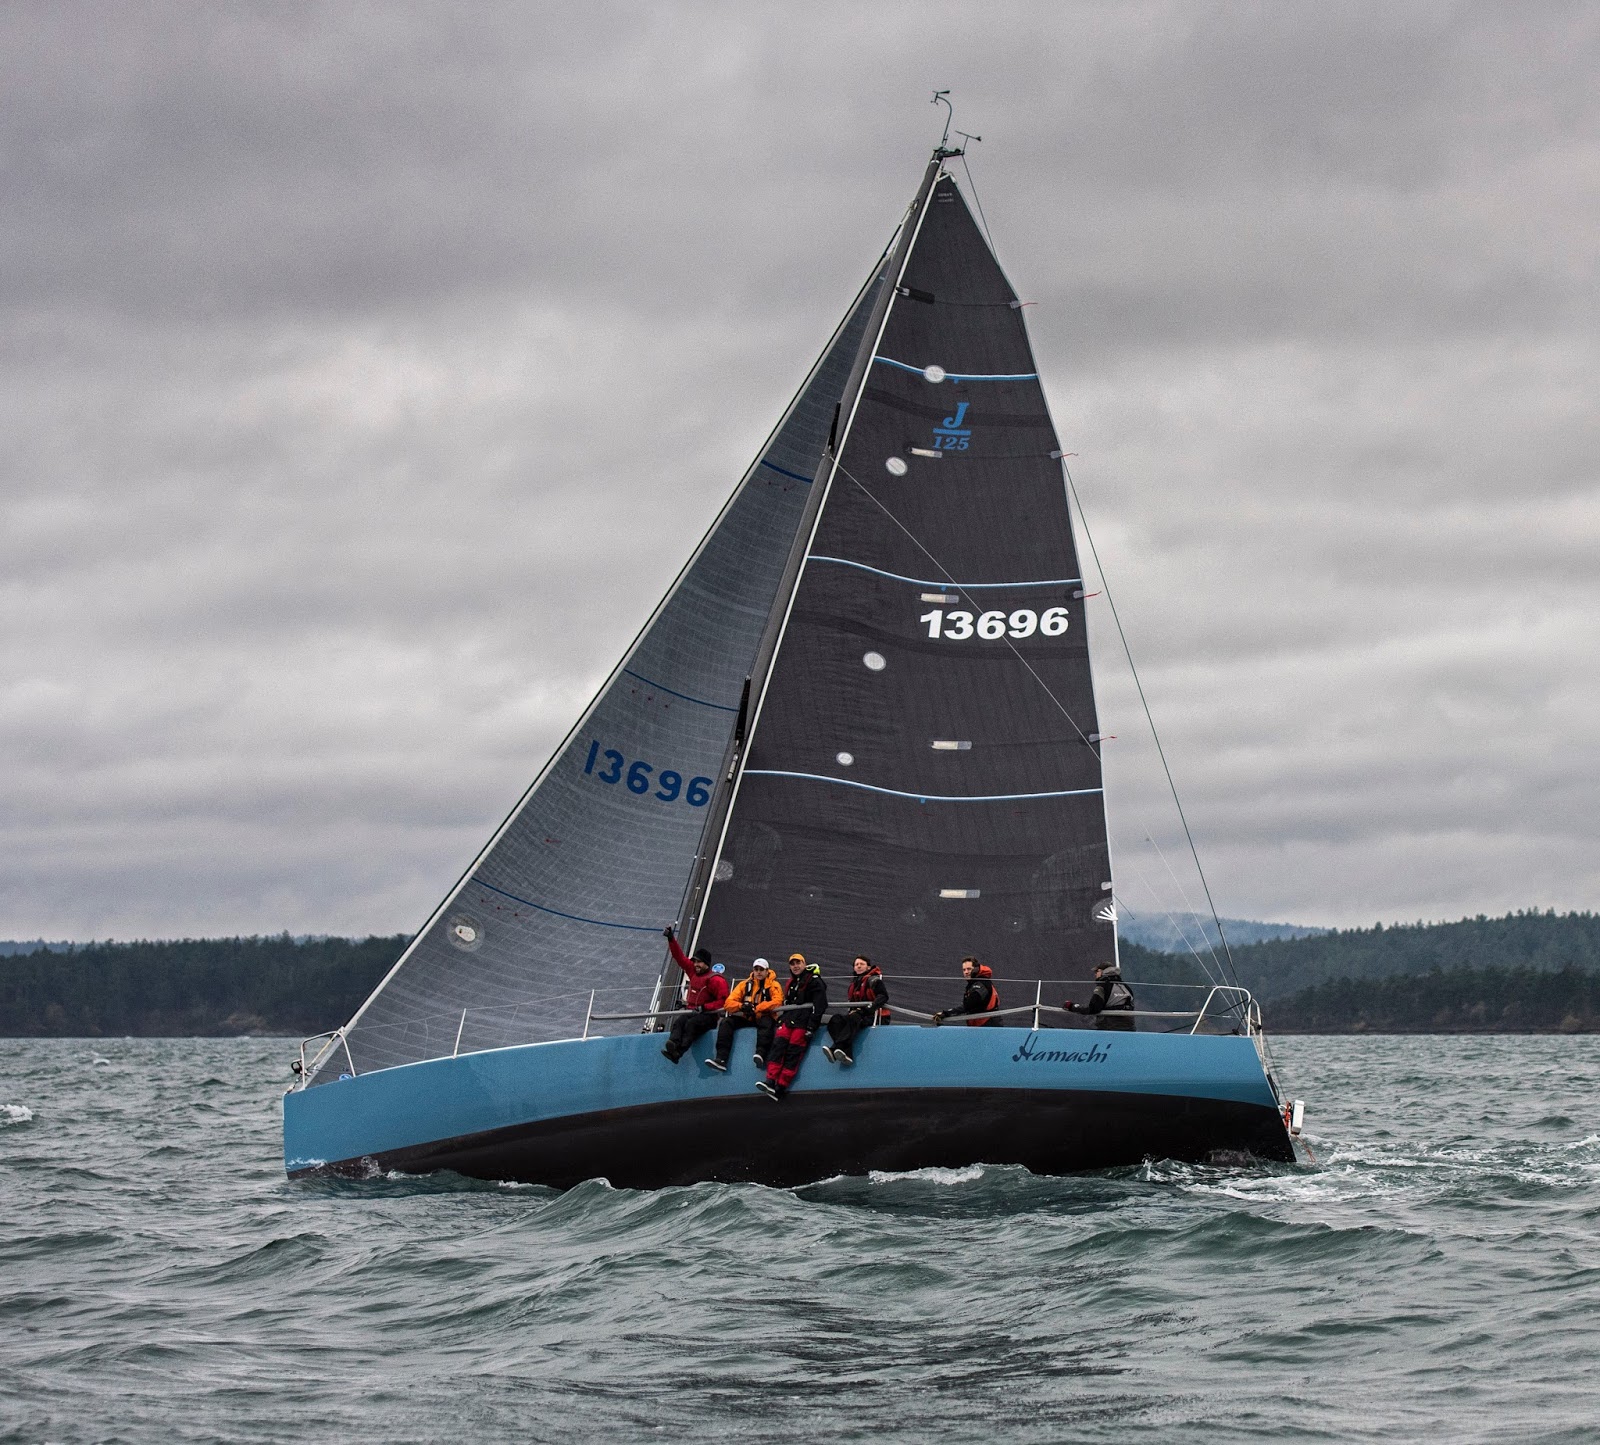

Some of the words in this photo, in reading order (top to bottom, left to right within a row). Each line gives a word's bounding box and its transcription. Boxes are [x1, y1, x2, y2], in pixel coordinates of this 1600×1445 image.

[942, 401, 970, 428] J
[933, 436, 970, 450] 125
[920, 607, 1069, 640] 13696
[584, 739, 714, 807] 13696
[1012, 1031, 1112, 1063] Hamachi
